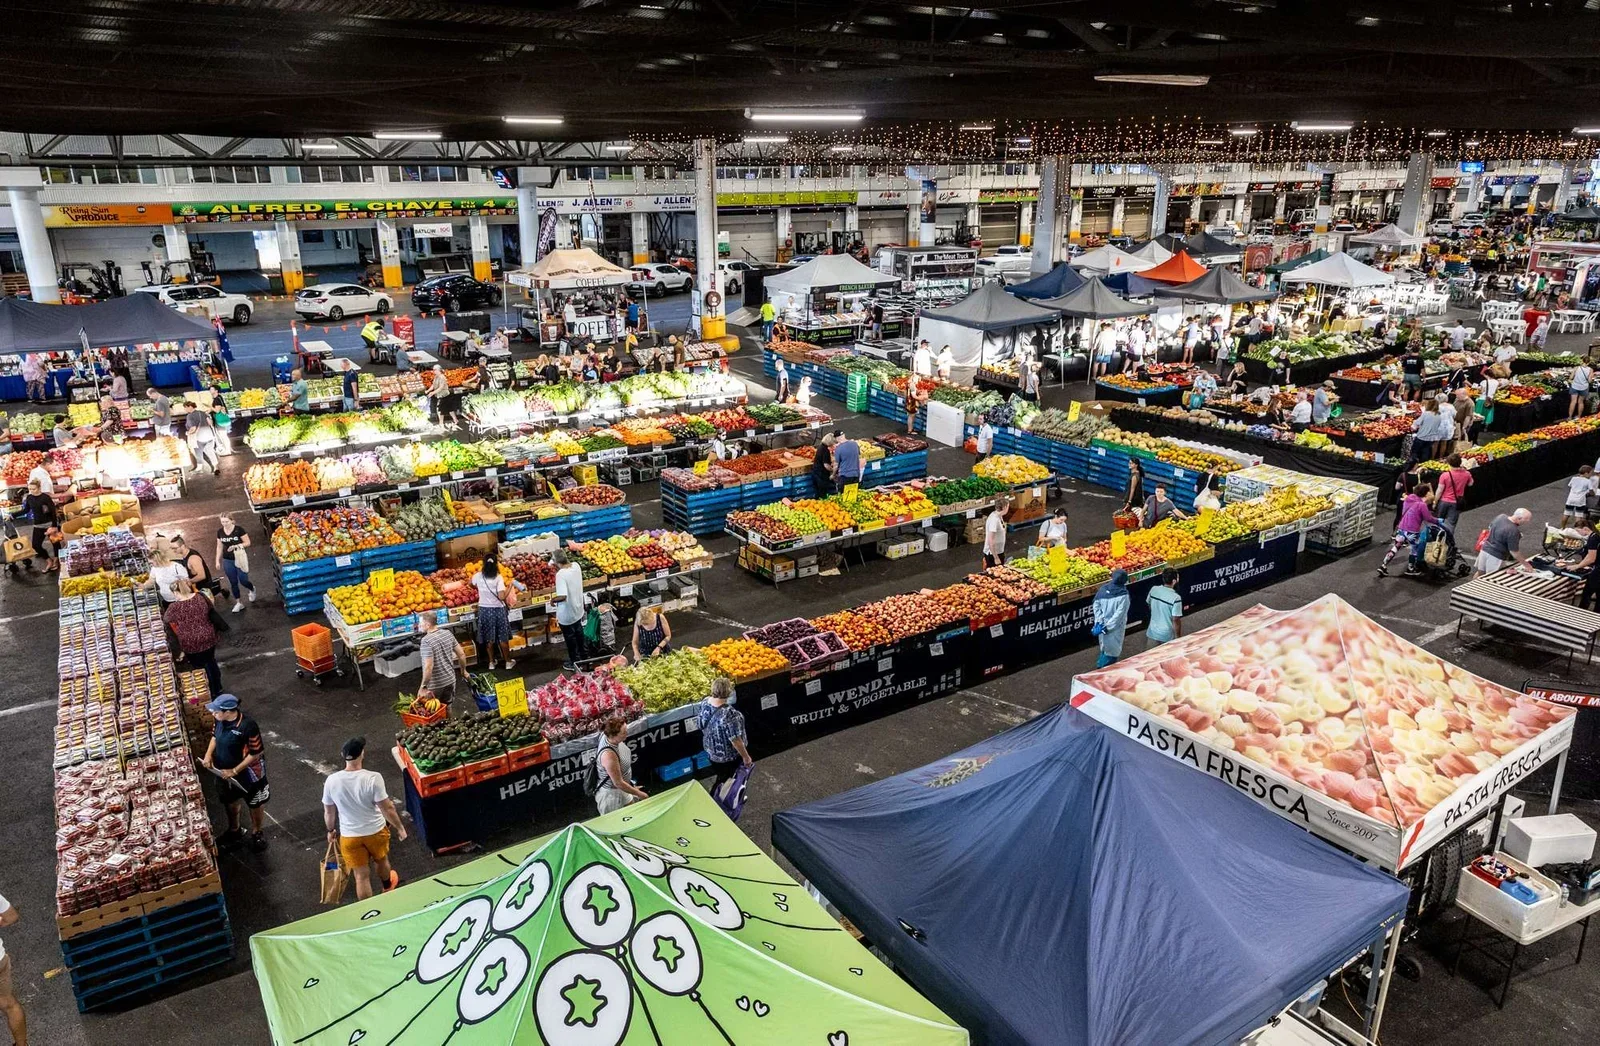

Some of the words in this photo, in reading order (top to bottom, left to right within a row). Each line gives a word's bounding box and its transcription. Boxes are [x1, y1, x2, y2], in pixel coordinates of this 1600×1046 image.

[59, 205, 89, 216] Rising
[90, 205, 109, 214] Sun
[210, 203, 322, 214] ALFRED
[335, 202, 358, 211] E.
[367, 201, 453, 211] CHAVE
[483, 199, 496, 208] 4
[583, 198, 613, 206] ALLEN
[653, 197, 662, 205] J.
[664, 196, 691, 204] ALLEN
[74, 213, 119, 221] PRODUCE
[575, 277, 607, 287] COFFEE
[1189, 580, 1219, 593] FRUIT
[1219, 578, 1227, 587] &
[1229, 561, 1275, 584] VEGETABLE
[1214, 558, 1256, 579] WENDY
[1020, 612, 1070, 637] HEALTHY
[1046, 623, 1073, 639] FRUIT
[1073, 620, 1081, 629] &
[828, 673, 895, 705] WENDY
[1529, 690, 1547, 700] ALL
[1548, 693, 1585, 705] ABOUT
[790, 707, 834, 725] FRUIT
[837, 704, 850, 714] &
[852, 677, 927, 710] VEGETABLE
[500, 754, 584, 800] HEALTHY
[1127, 714, 1199, 767] PASTA
[1206, 751, 1310, 823] FRESCA
[548, 768, 589, 791] FRUIT
[1443, 781, 1489, 828] PASTA
[1491, 745, 1542, 795] FRESCA
[1323, 809, 1350, 830] Since
[1352, 825, 1379, 842] 2007
